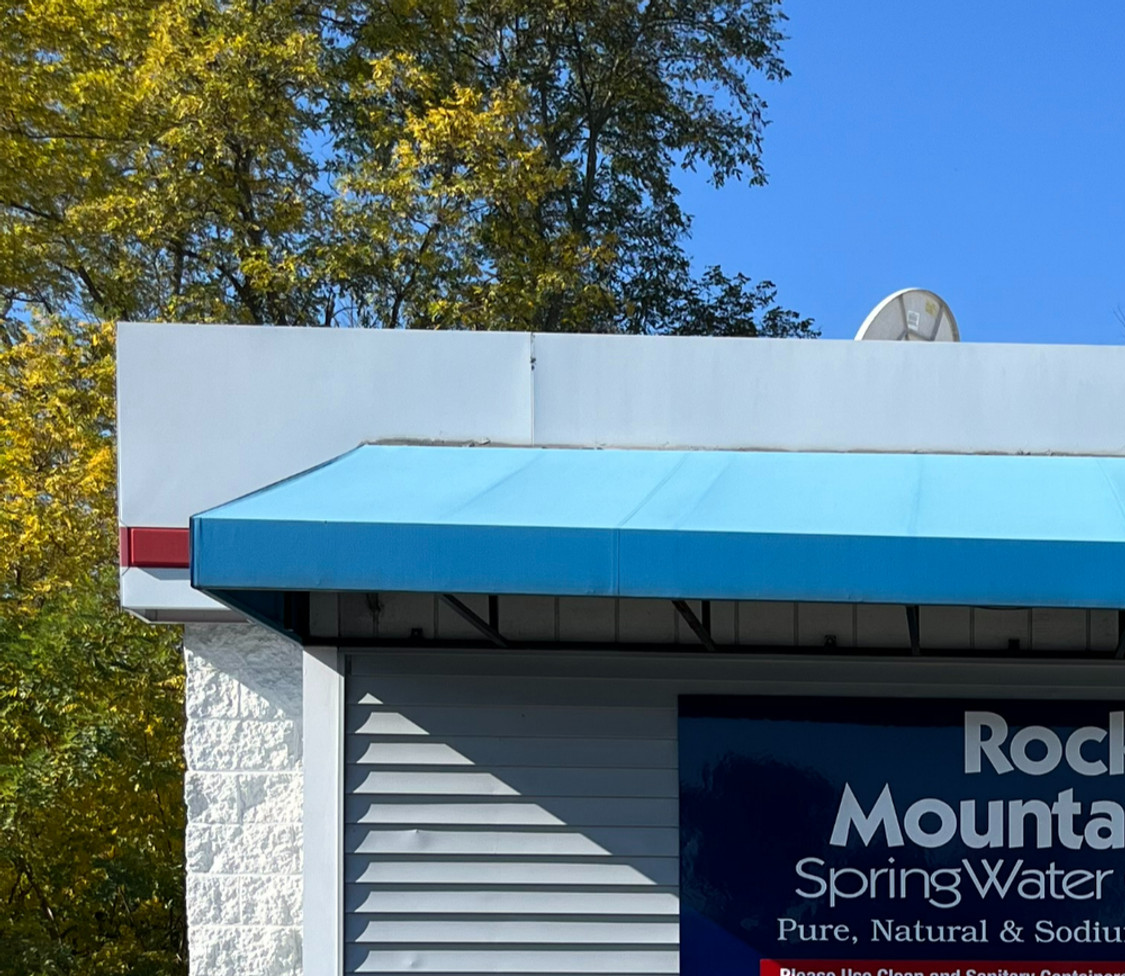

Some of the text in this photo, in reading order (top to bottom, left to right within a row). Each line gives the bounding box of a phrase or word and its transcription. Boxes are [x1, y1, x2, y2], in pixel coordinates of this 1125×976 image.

[777, 918, 858, 944] Pure,
[871, 919, 989, 943] Natural
[999, 919, 1024, 943] &
